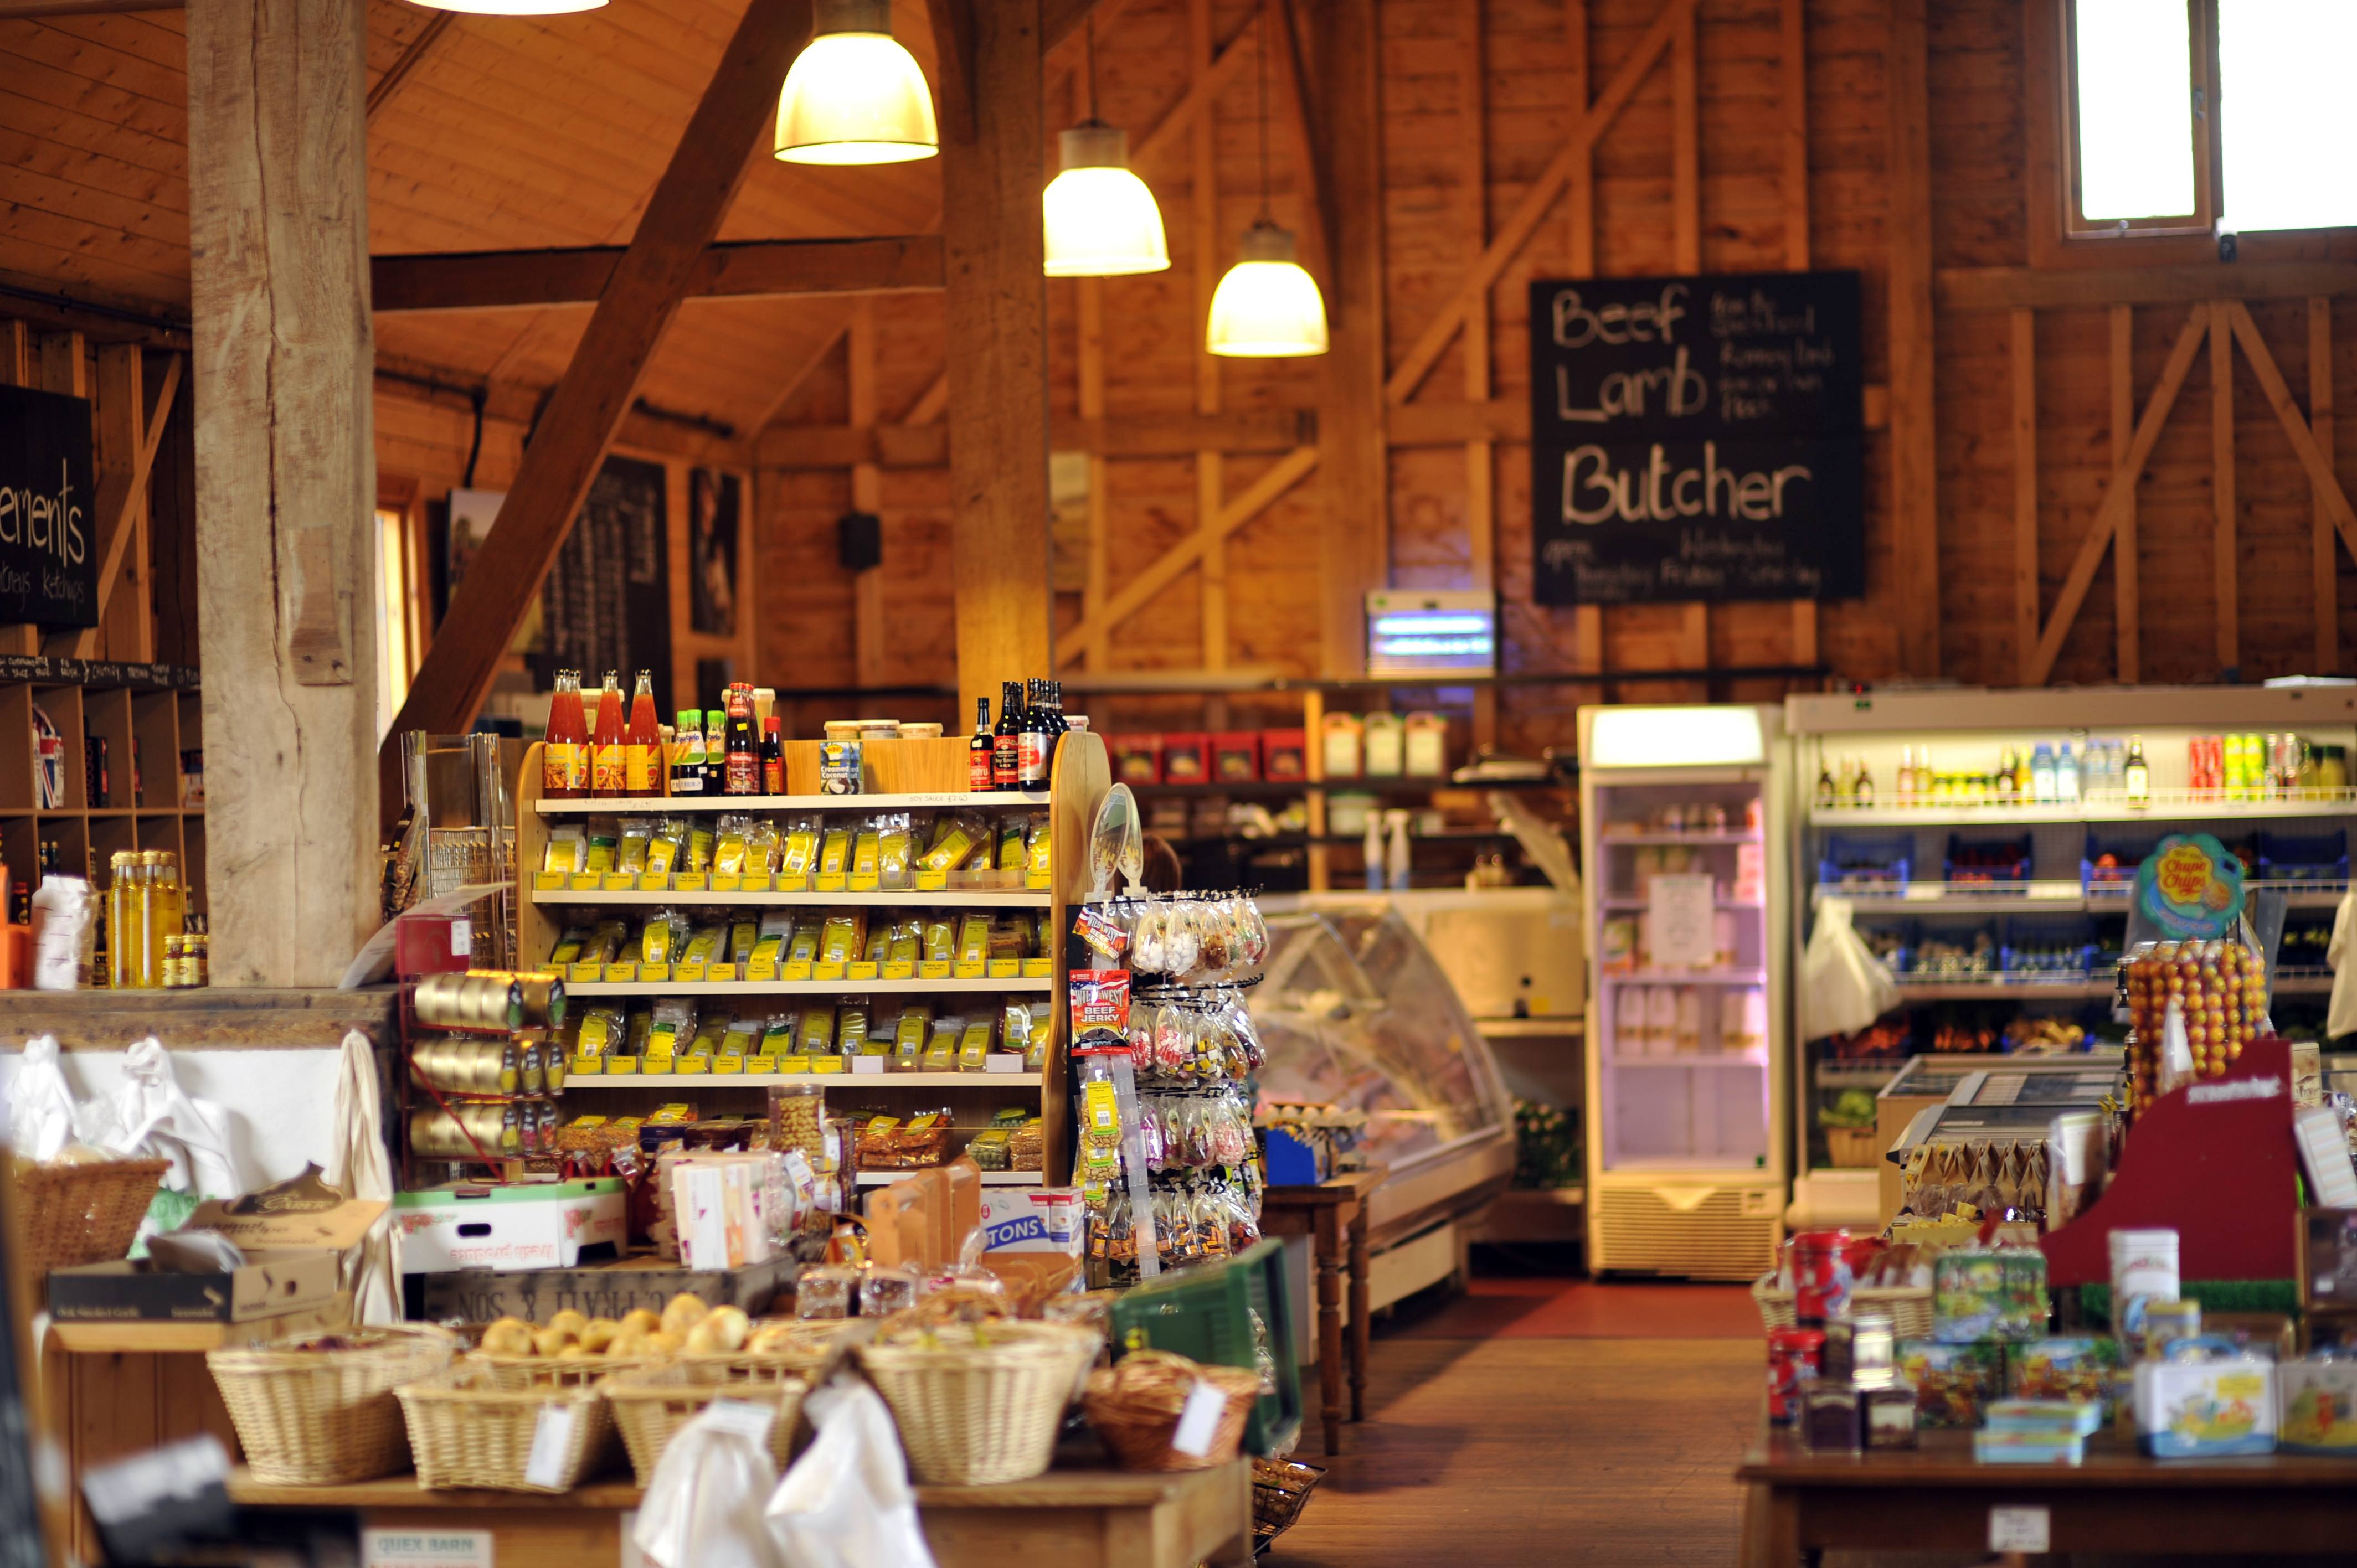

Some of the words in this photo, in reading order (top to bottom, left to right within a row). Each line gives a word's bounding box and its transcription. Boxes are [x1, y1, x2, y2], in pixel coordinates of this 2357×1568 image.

[1552, 283, 1690, 348] Beef
[1555, 344, 1708, 422] Lamb
[1562, 440, 1812, 525] Butcher
[2164, 873, 2206, 889] Chups
[1085, 932, 1109, 950] JERKY
[1090, 928, 1109, 942] BEEF
[1075, 989, 1097, 1008] WIL
[1102, 989, 1124, 1007] WEST
[1080, 1014, 1120, 1022] JERKY
[987, 1219, 1039, 1246] TONS
[450, 1245, 511, 1263] produce
[515, 1244, 554, 1262] fresh
[458, 1292, 504, 1322] SON
[378, 1538, 422, 1554] QUEX
[428, 1539, 474, 1552] BARN
